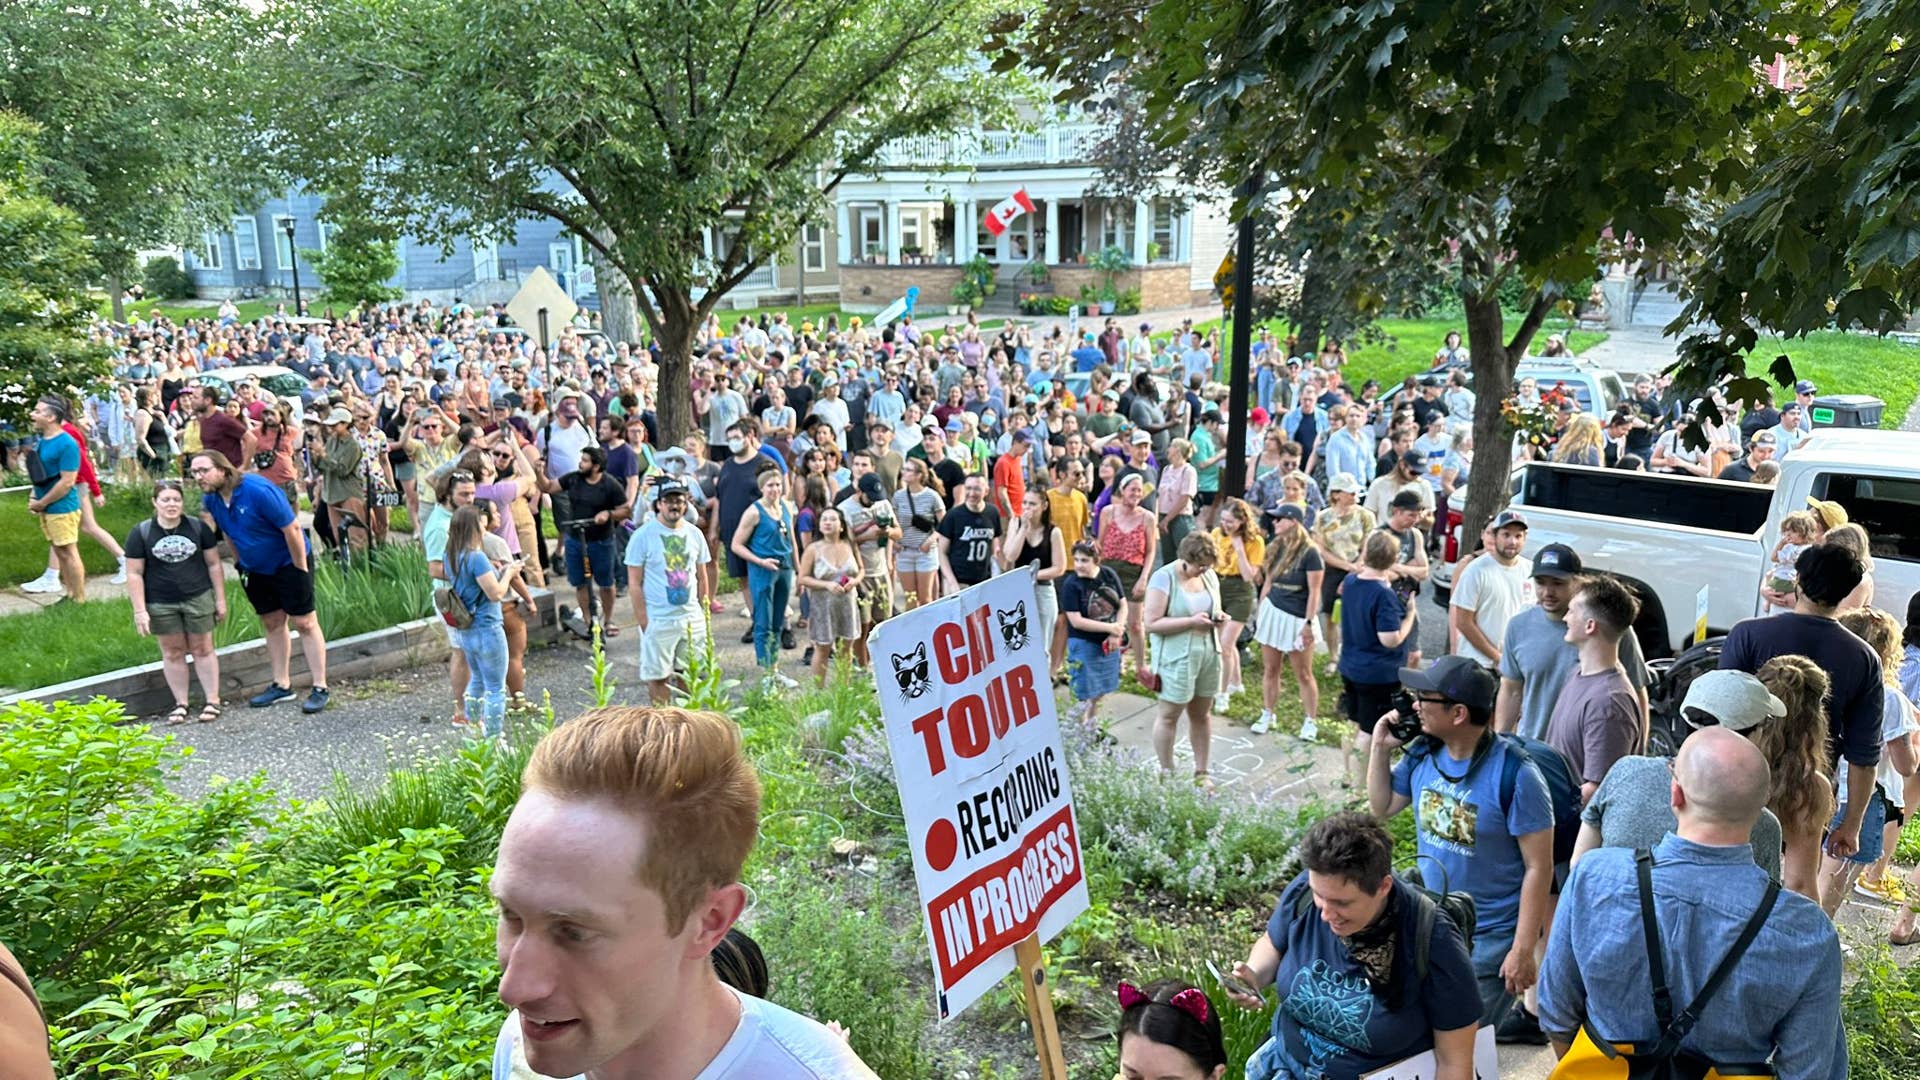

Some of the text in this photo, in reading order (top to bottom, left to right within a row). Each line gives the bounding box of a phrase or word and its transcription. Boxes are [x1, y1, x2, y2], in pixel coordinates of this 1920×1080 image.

[376, 493, 399, 506] 2109
[967, 540, 988, 561] 10
[933, 603, 995, 685] CAT
[912, 664, 1040, 776] TOUR
[957, 746, 1060, 860] RECORDING
[940, 822, 1075, 968] IN PROGRESS
